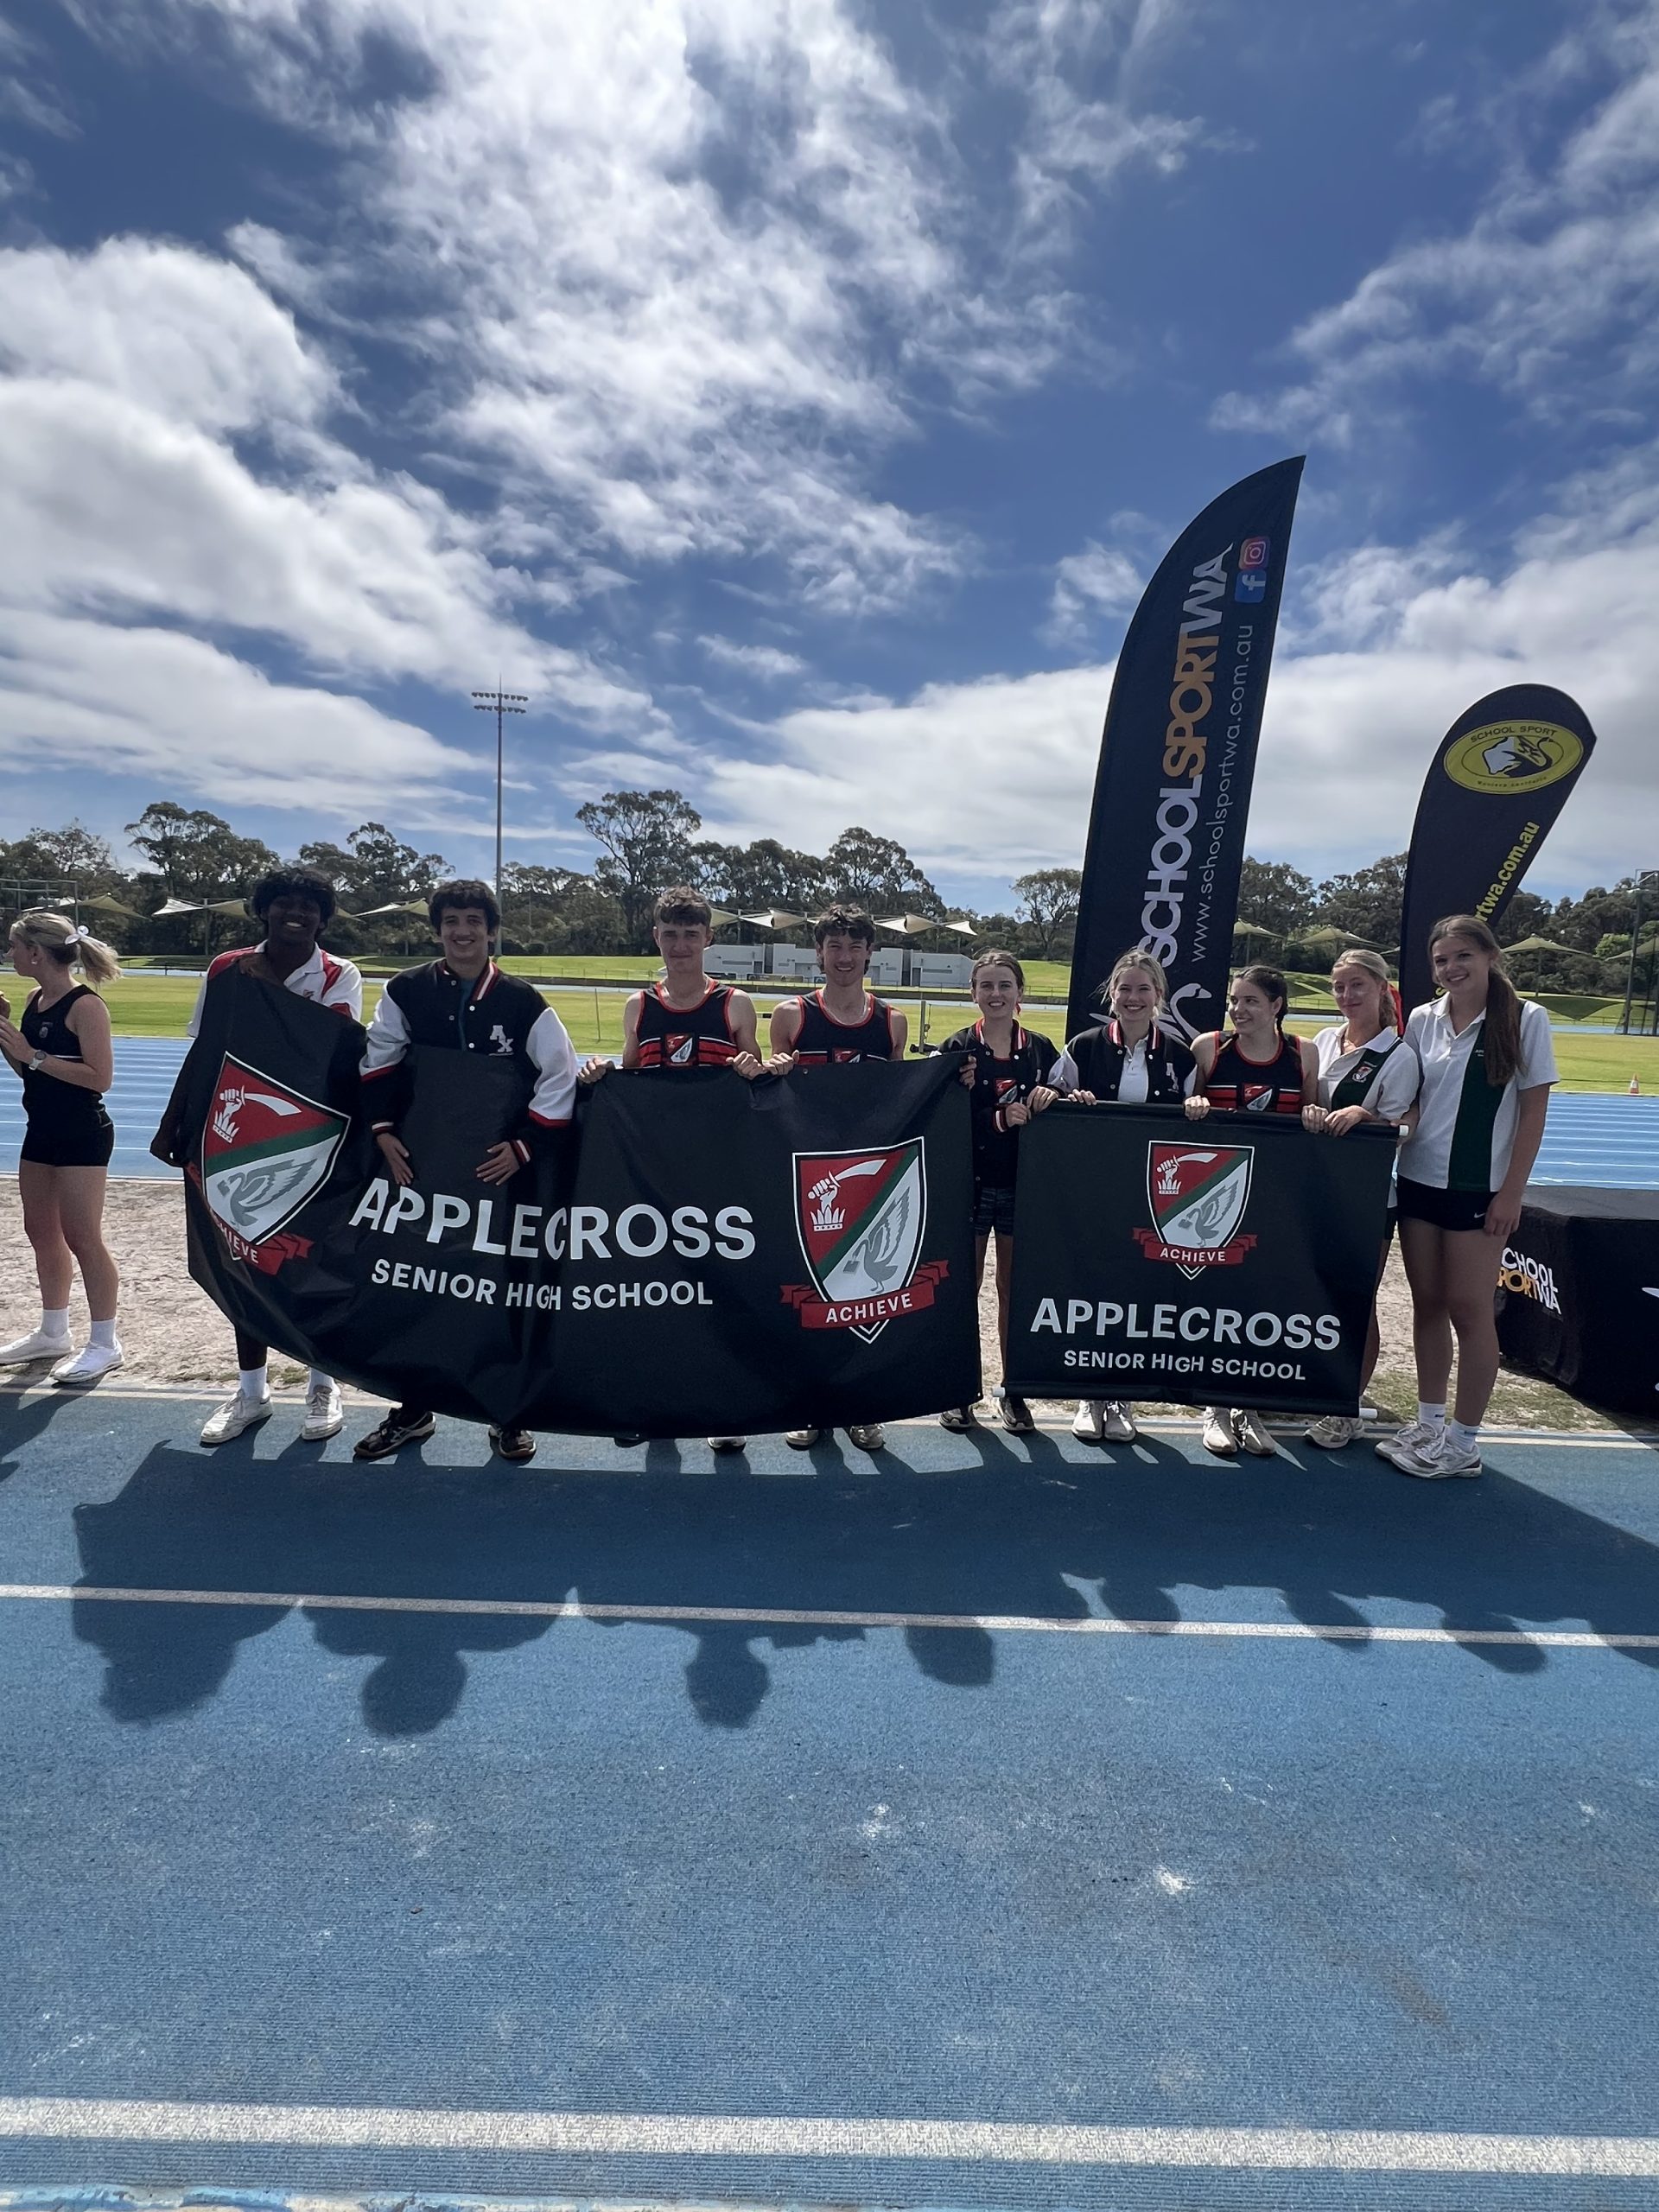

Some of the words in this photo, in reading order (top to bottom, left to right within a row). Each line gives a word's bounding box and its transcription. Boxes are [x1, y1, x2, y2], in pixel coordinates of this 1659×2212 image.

[1471, 727, 1515, 743] SCHOOL
[1520, 725, 1558, 737] SPORT
[1192, 625, 1253, 963] www.schoolsportwa.com.au
[1474, 821, 1540, 922] rtwa.com.au
[348, 1178, 755, 1260] APPLECROSS
[1160, 1247, 1226, 1262] ACHIEVE
[1501, 1247, 1559, 1294] CHOOL
[372, 1259, 497, 1305] SENIOR
[505, 1282, 562, 1310] HIGH
[572, 1281, 713, 1310] SCHOOL
[825, 1293, 912, 1324] ACHIEVE
[1497, 1267, 1562, 1315] PORTWA
[1030, 1298, 1341, 1351] APPLECROSS
[1064, 1350, 1145, 1369] SENIOR
[1151, 1353, 1205, 1373] HIGH
[1211, 1357, 1306, 1380] SCHOOL
